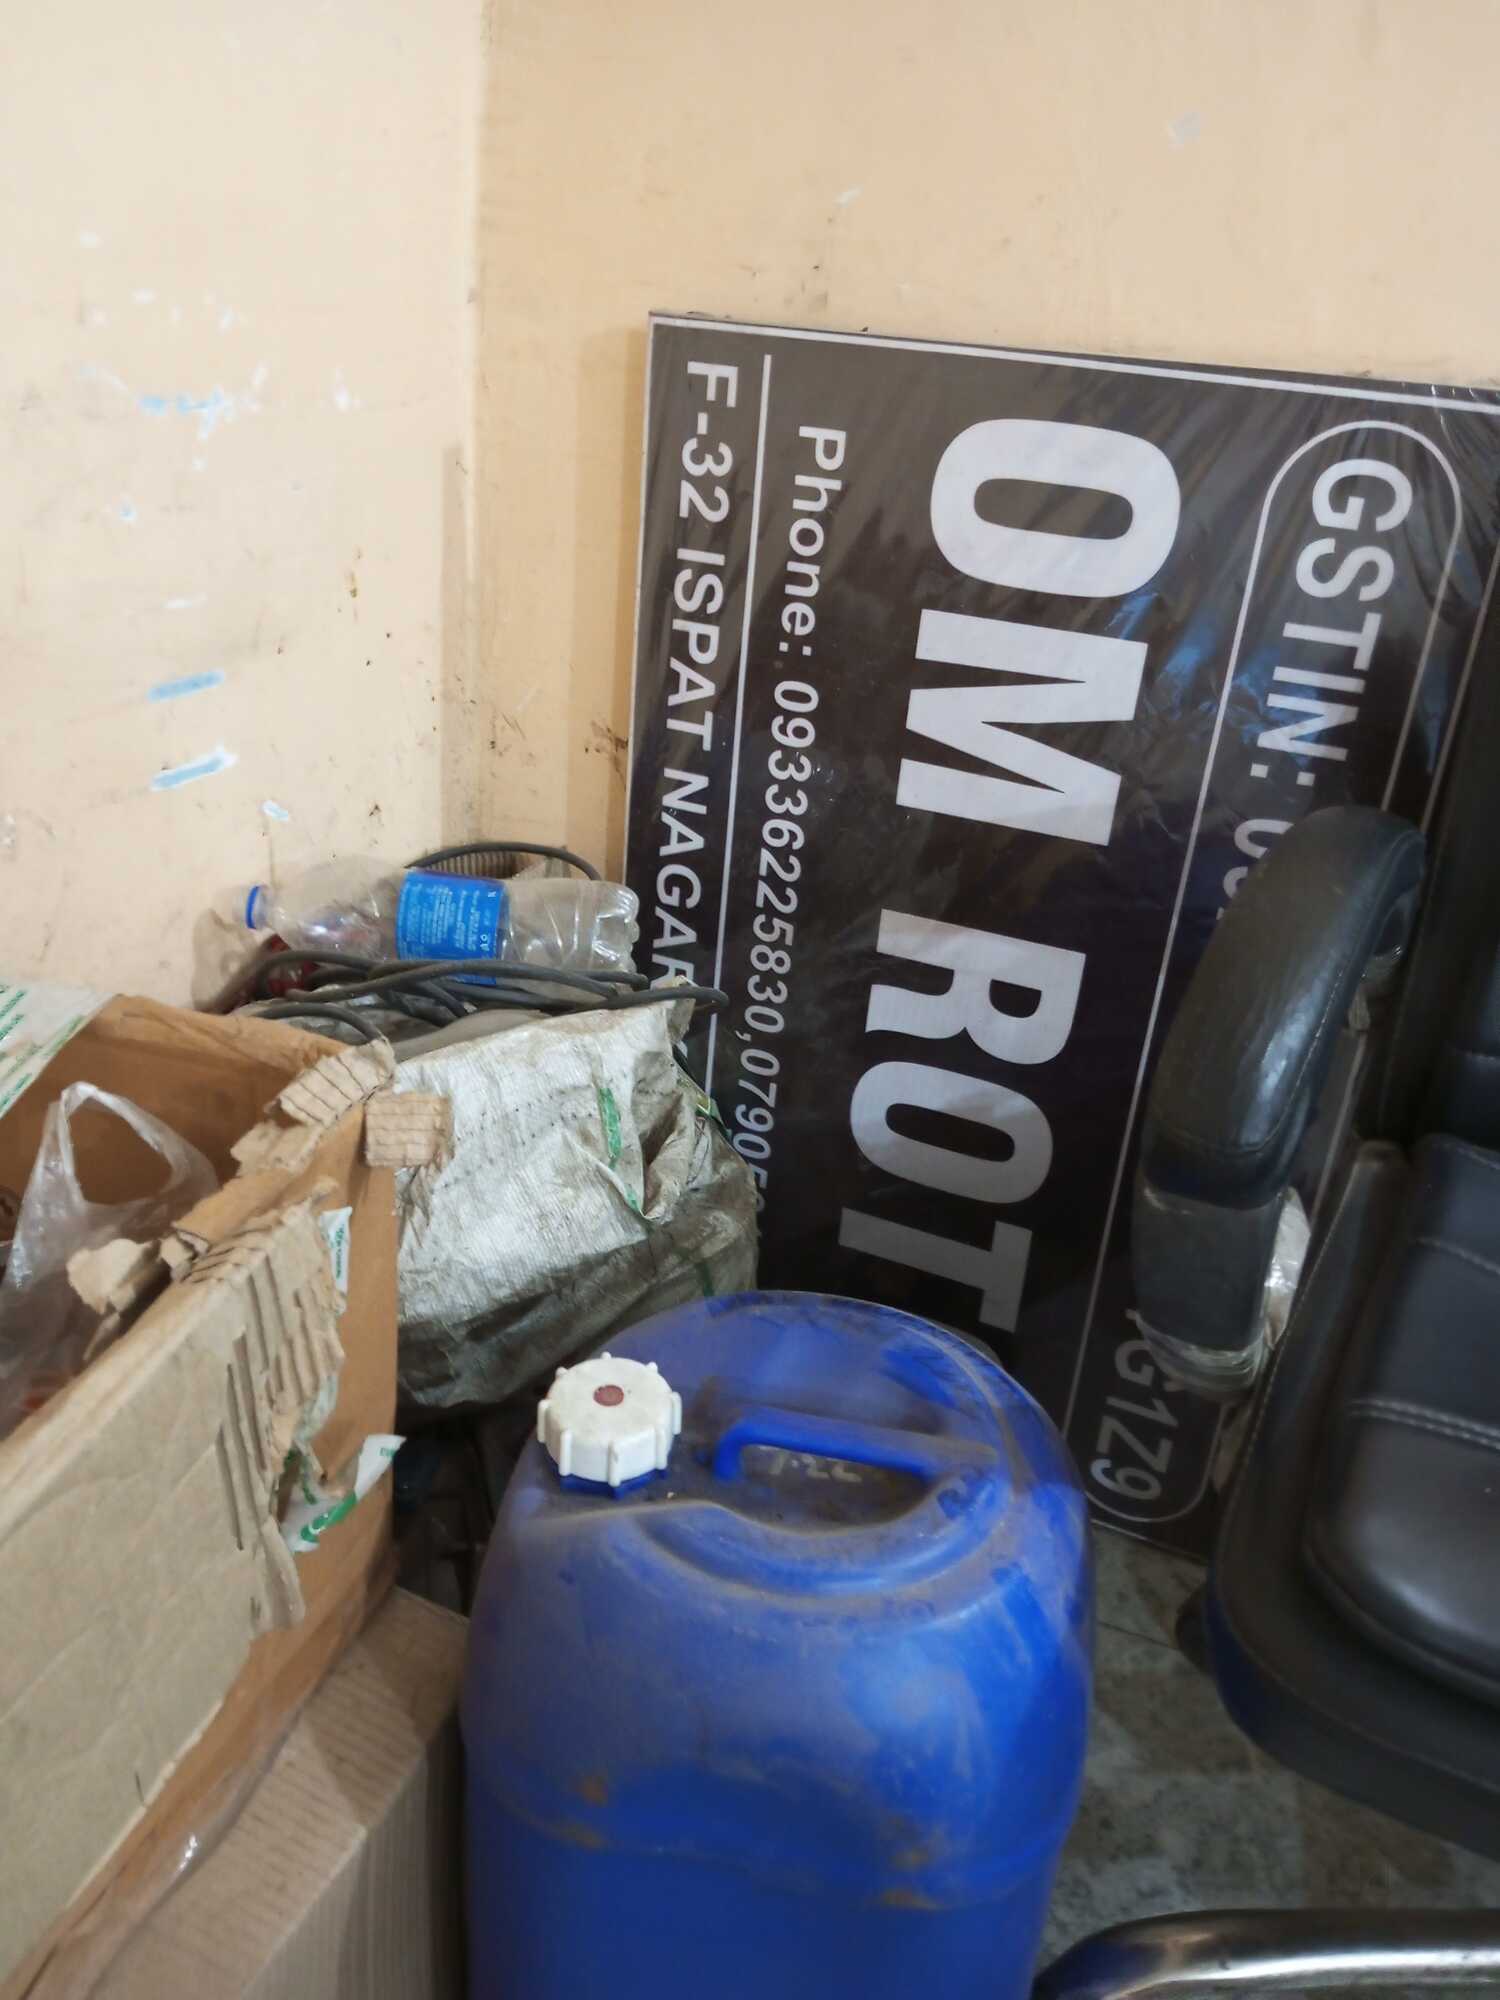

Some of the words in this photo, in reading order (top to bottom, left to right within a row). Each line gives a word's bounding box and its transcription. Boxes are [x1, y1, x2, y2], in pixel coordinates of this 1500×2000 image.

[679, 360, 738, 523] F-32
[779, 425, 847, 657] Phone:
[666, 548, 726, 752] ISPAT
[896, 418, 1181, 847] OM
[1250, 458, 1413, 786] GSTIN:
[650, 767, 710, 990] NAGAR
[838, 908, 1087, 1334] ROT
